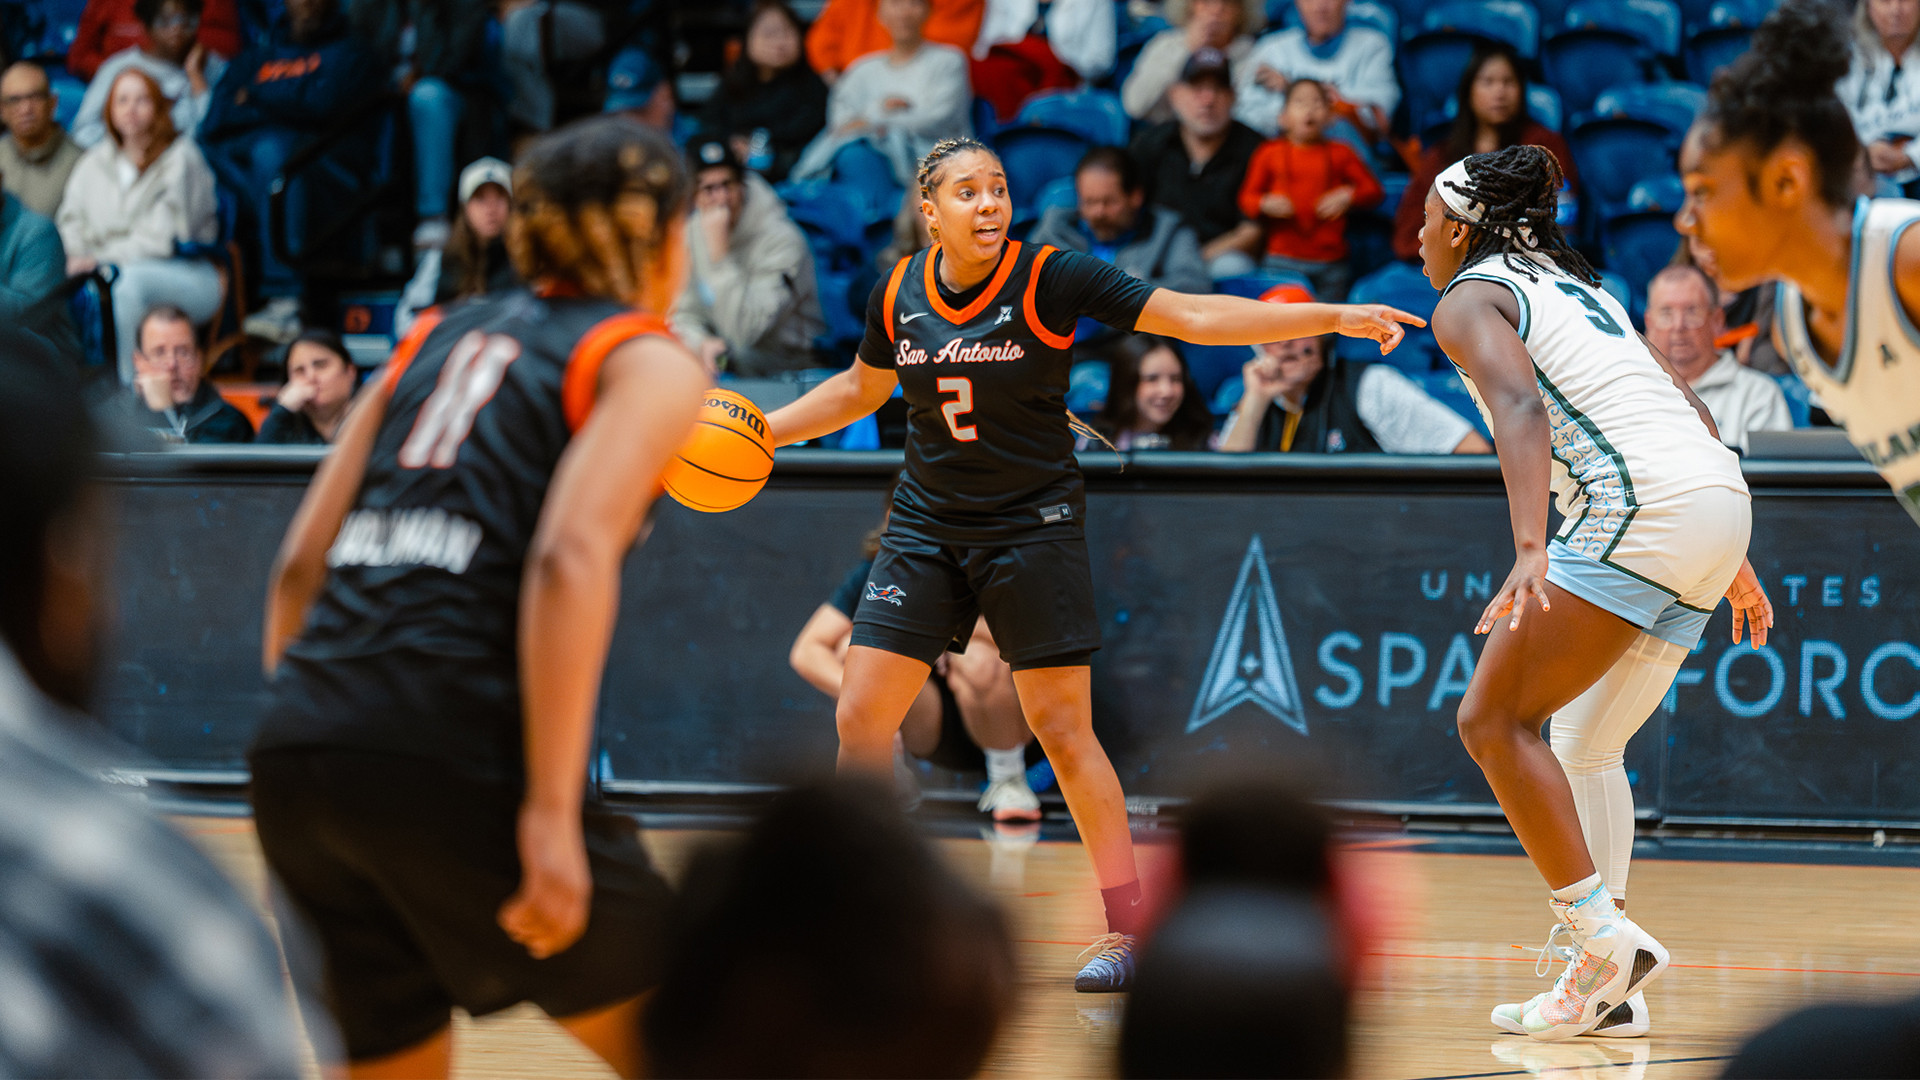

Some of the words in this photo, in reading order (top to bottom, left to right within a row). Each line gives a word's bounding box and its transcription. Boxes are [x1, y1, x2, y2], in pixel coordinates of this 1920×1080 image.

[1554, 281, 1625, 338] 3
[896, 339, 928, 366] San
[933, 338, 1024, 364] Antonio
[398, 329, 522, 469] 11
[936, 376, 978, 442] 2
[1780, 573, 1882, 608] TES
[1313, 630, 1476, 711] SPA
[1662, 638, 1920, 721] FORC
